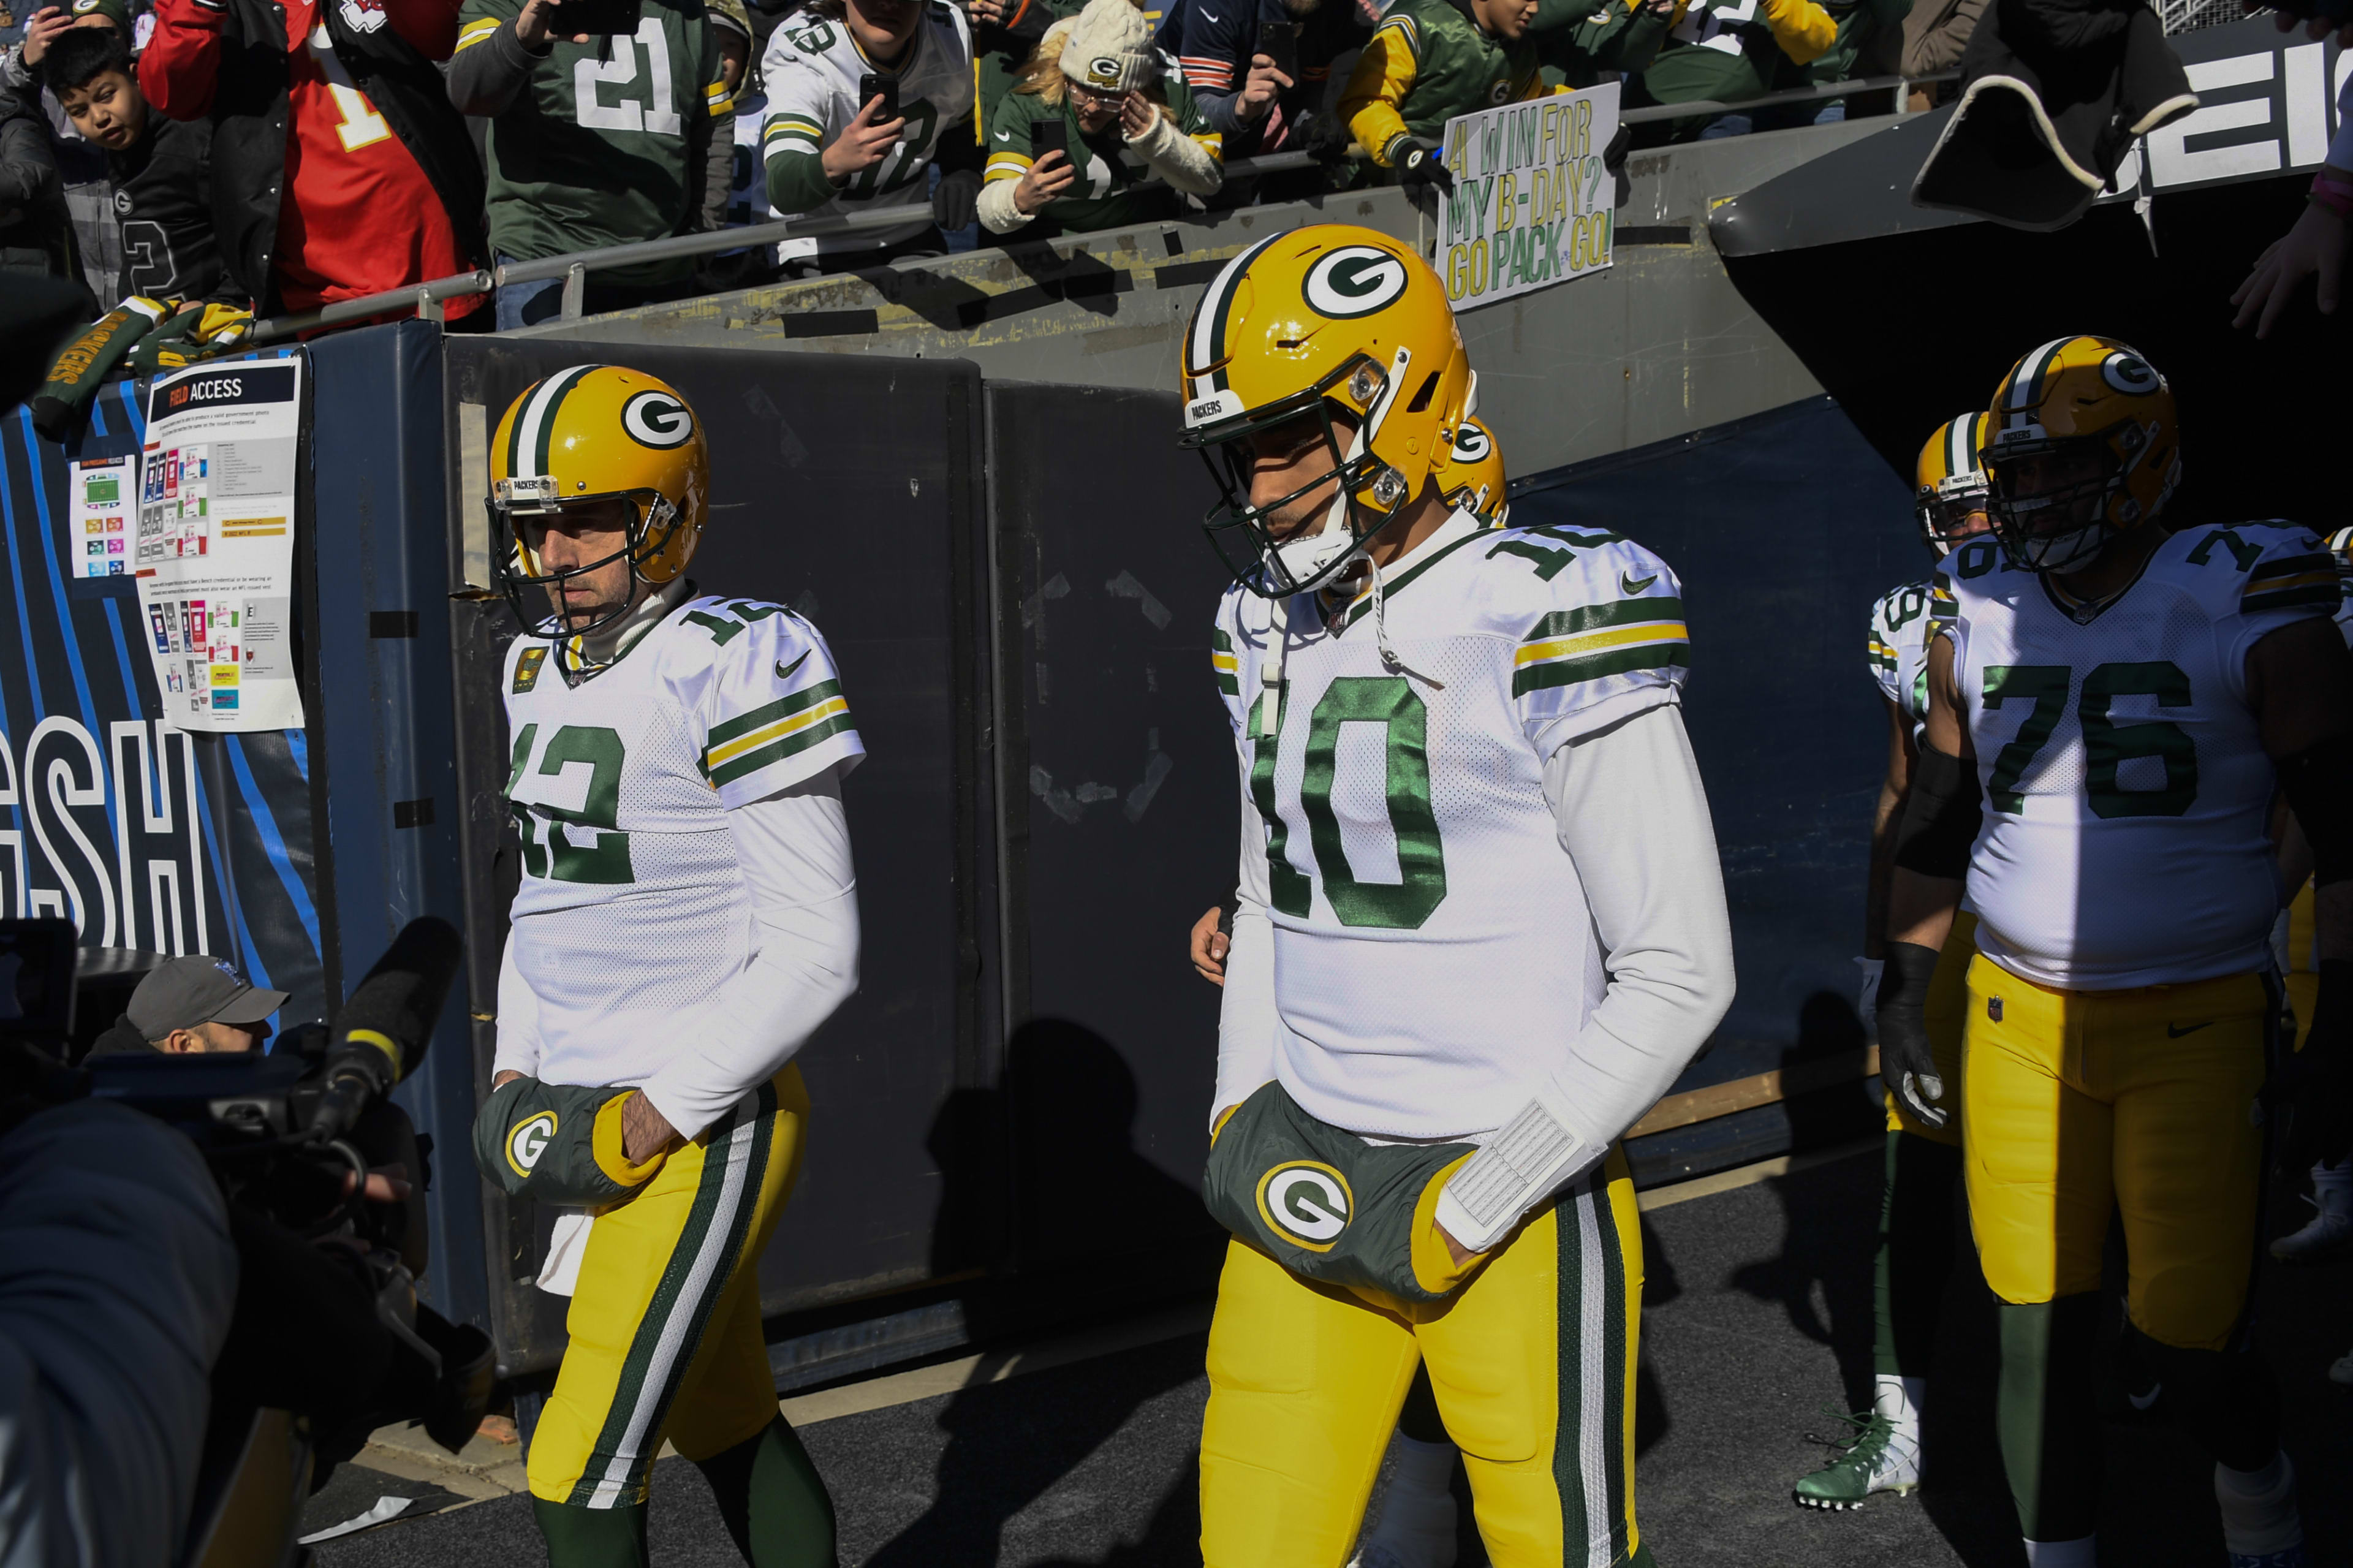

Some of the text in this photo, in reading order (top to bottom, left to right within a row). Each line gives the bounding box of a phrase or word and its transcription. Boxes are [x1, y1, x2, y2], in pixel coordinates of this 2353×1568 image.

[574, 17, 681, 135] 21
[1448, 99, 1592, 180] A WIN FOR
[1446, 156, 1602, 246] MY B-DAY?
[1305, 247, 1407, 315] G
[1447, 208, 1612, 301] GO PACK GO!
[169, 377, 242, 408] FIELD ACCESS
[2102, 351, 2161, 395] G
[624, 392, 694, 448] G
[1191, 400, 1222, 421] PACKERS
[2003, 430, 2031, 443] PACKERS
[1452, 422, 1490, 461] G
[514, 480, 538, 490] PACKERS
[248, 607, 253, 617] E
[517, 648, 545, 681] C
[1982, 661, 2198, 819] 76
[504, 723, 636, 884] 12
[1246, 676, 1447, 930] 10
[513, 1118, 552, 1168] G
[1267, 1168, 1347, 1240] G
